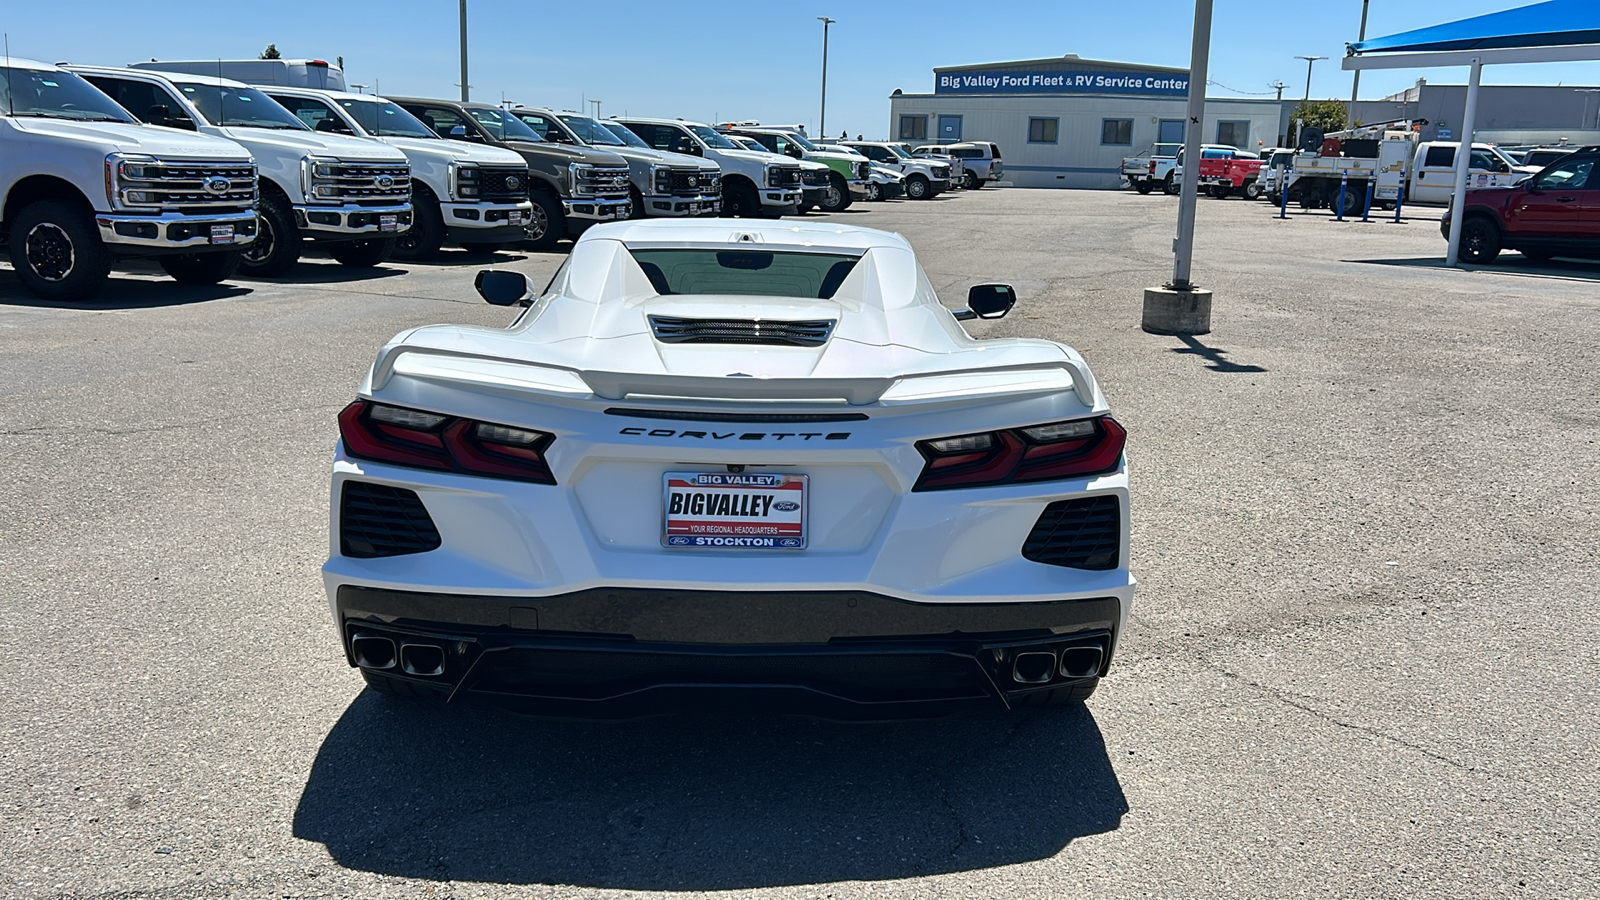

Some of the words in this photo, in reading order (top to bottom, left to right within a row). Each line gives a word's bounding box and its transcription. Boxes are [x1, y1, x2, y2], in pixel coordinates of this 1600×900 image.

[941, 76, 961, 89] Big
[962, 76, 1000, 88] Valley
[1002, 75, 1029, 86] Ford
[1032, 75, 1064, 86] Fleet
[1066, 77, 1072, 86] &
[1075, 75, 1094, 86] RV
[1096, 76, 1142, 88] Service
[1145, 77, 1188, 90] Center
[619, 427, 851, 440] CORVETTE
[699, 475, 722, 484] BIG
[725, 476, 773, 485] VALLEY
[668, 492, 774, 517] BIGVALLEY
[690, 525, 706, 533] YOUR
[707, 526, 734, 534] REGIONAL
[734, 526, 778, 535] HEADQUARTERS
[695, 537, 774, 546] STOCKTON
